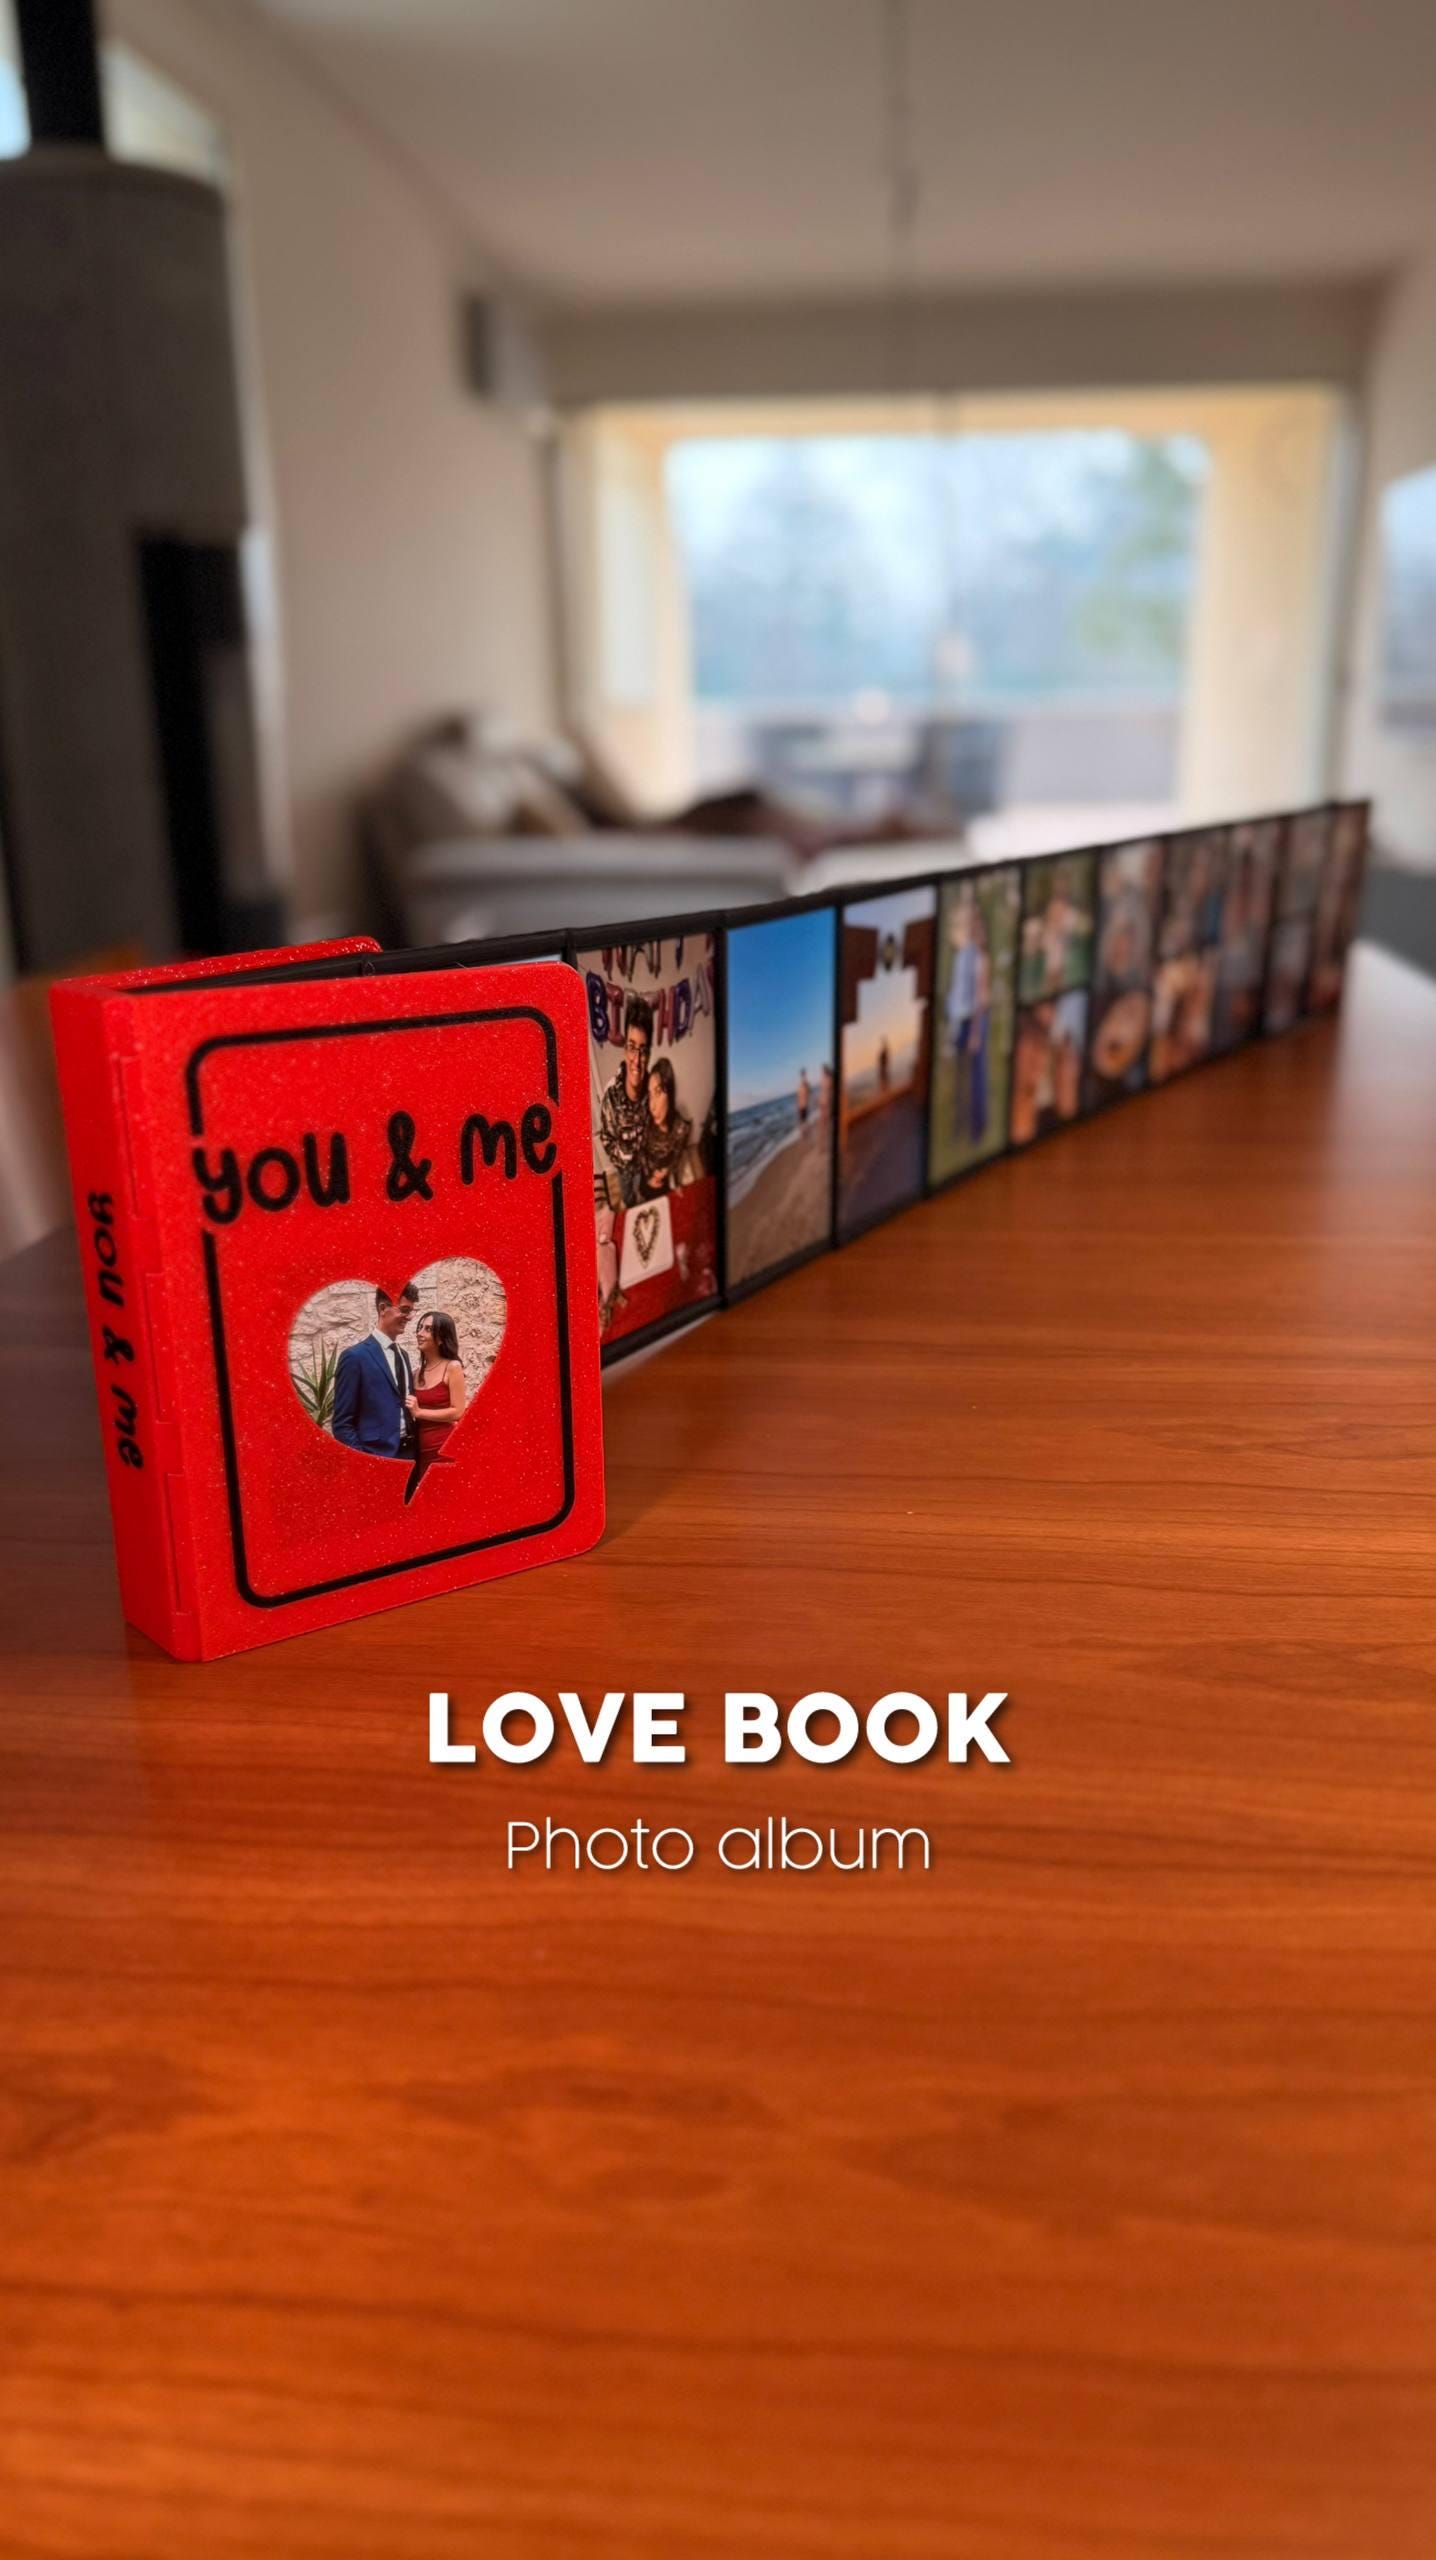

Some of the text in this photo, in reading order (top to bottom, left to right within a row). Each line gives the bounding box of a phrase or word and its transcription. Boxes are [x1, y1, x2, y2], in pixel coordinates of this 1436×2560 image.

[192, 1103, 557, 1225] you & me
[87, 1191, 144, 1469] you & me
